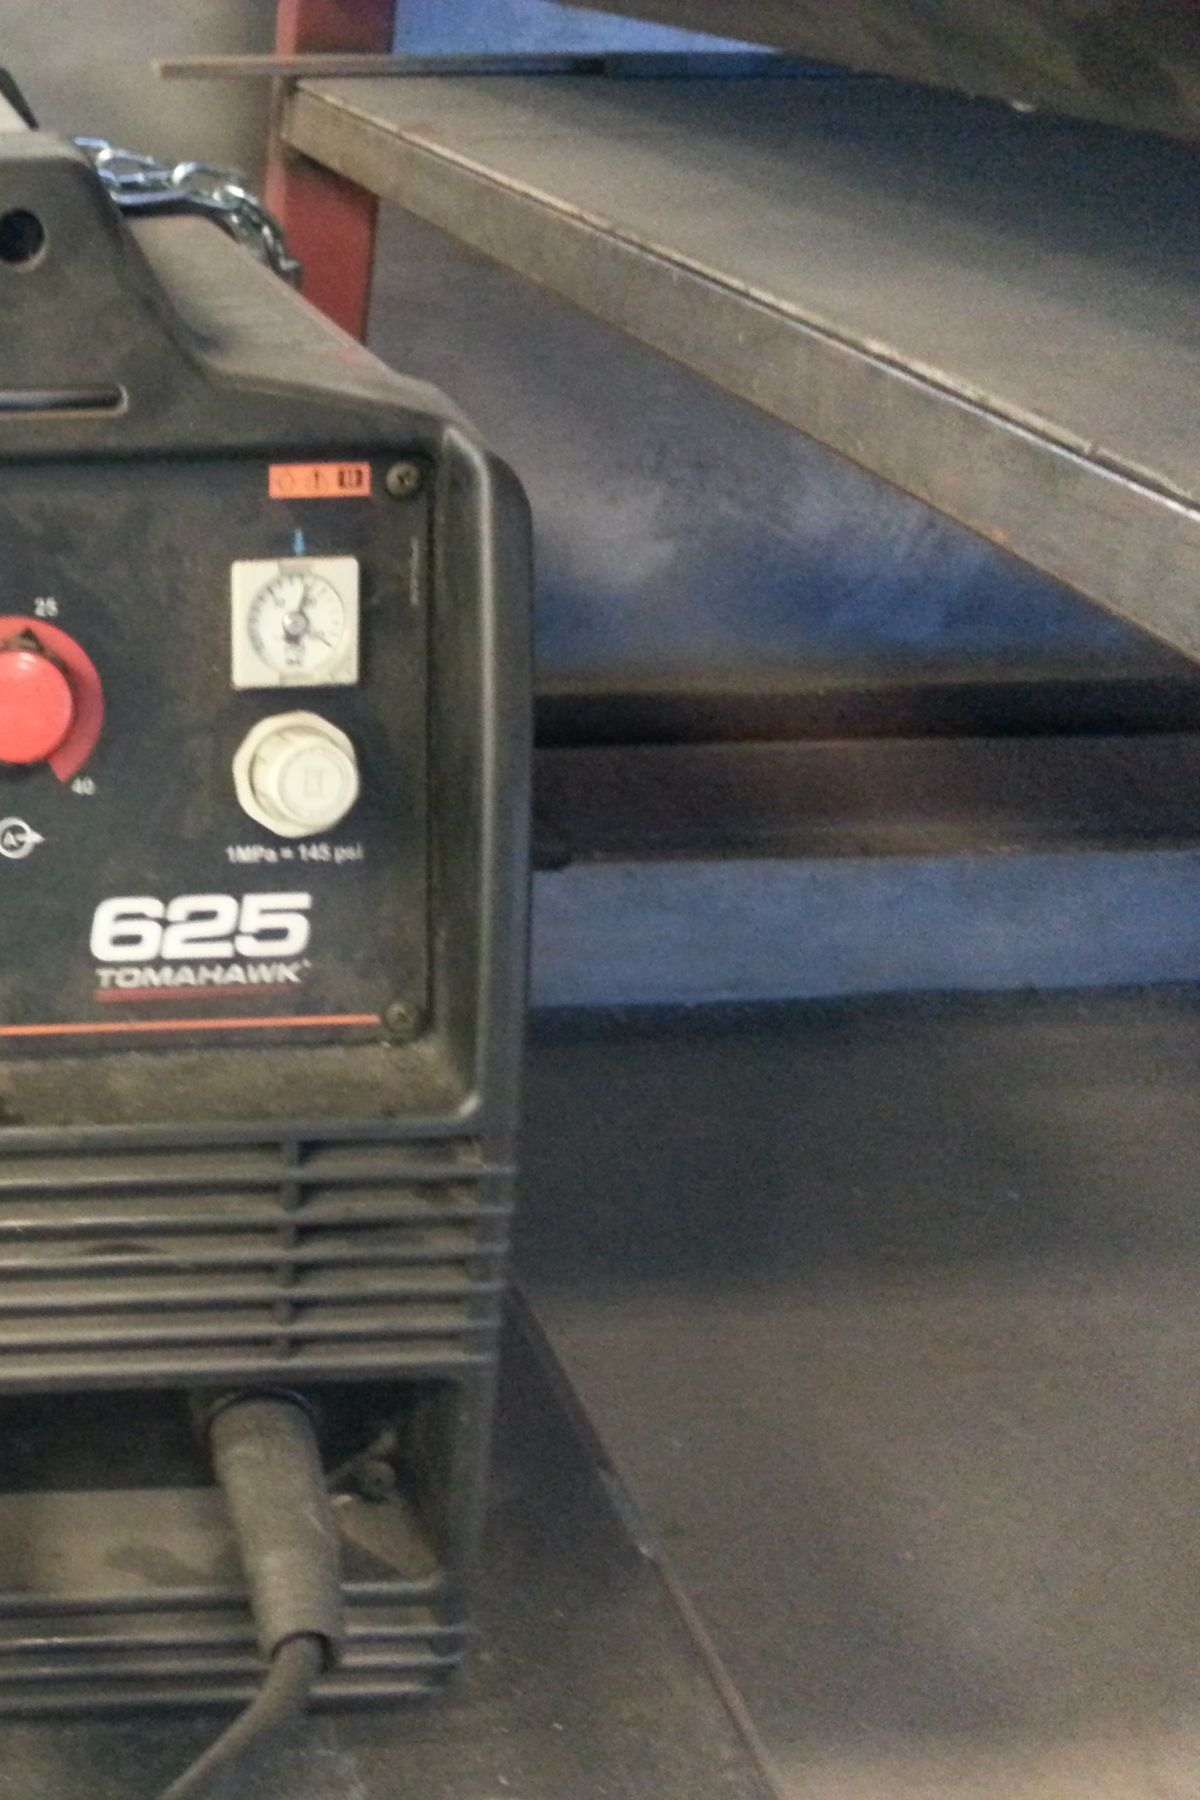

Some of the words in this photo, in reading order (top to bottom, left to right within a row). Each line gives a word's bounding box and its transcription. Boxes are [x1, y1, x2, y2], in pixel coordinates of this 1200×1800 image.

[71, 776, 97, 796] 40
[298, 843, 332, 862] 145
[90, 891, 313, 962] 625
[95, 961, 303, 989] TOMAHAWK
